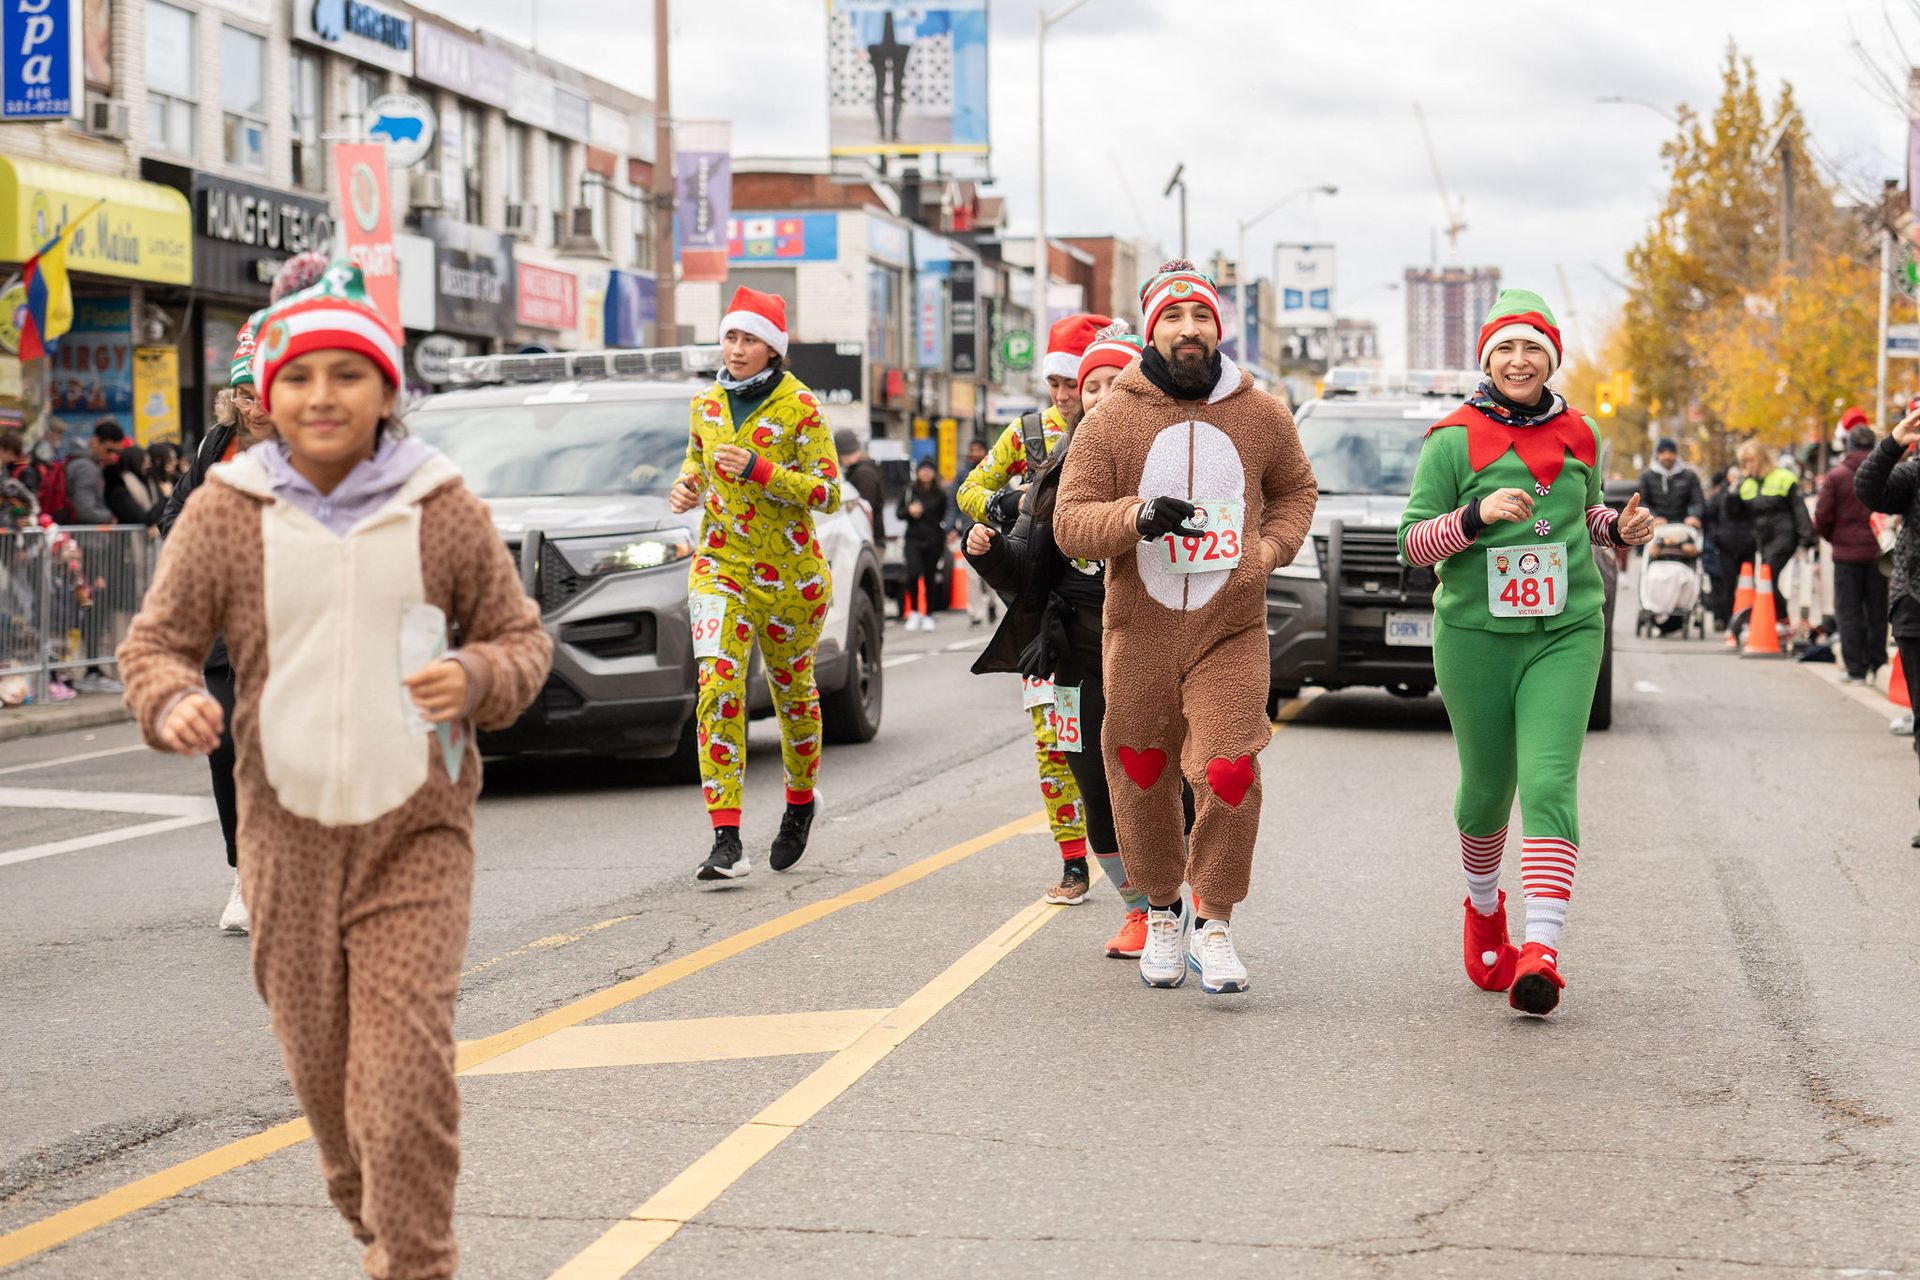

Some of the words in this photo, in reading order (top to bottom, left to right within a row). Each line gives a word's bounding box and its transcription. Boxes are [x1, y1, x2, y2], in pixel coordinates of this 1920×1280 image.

[1163, 529, 1240, 564] 1923
[1500, 576, 1555, 608] 481
[691, 617, 720, 641] 69
